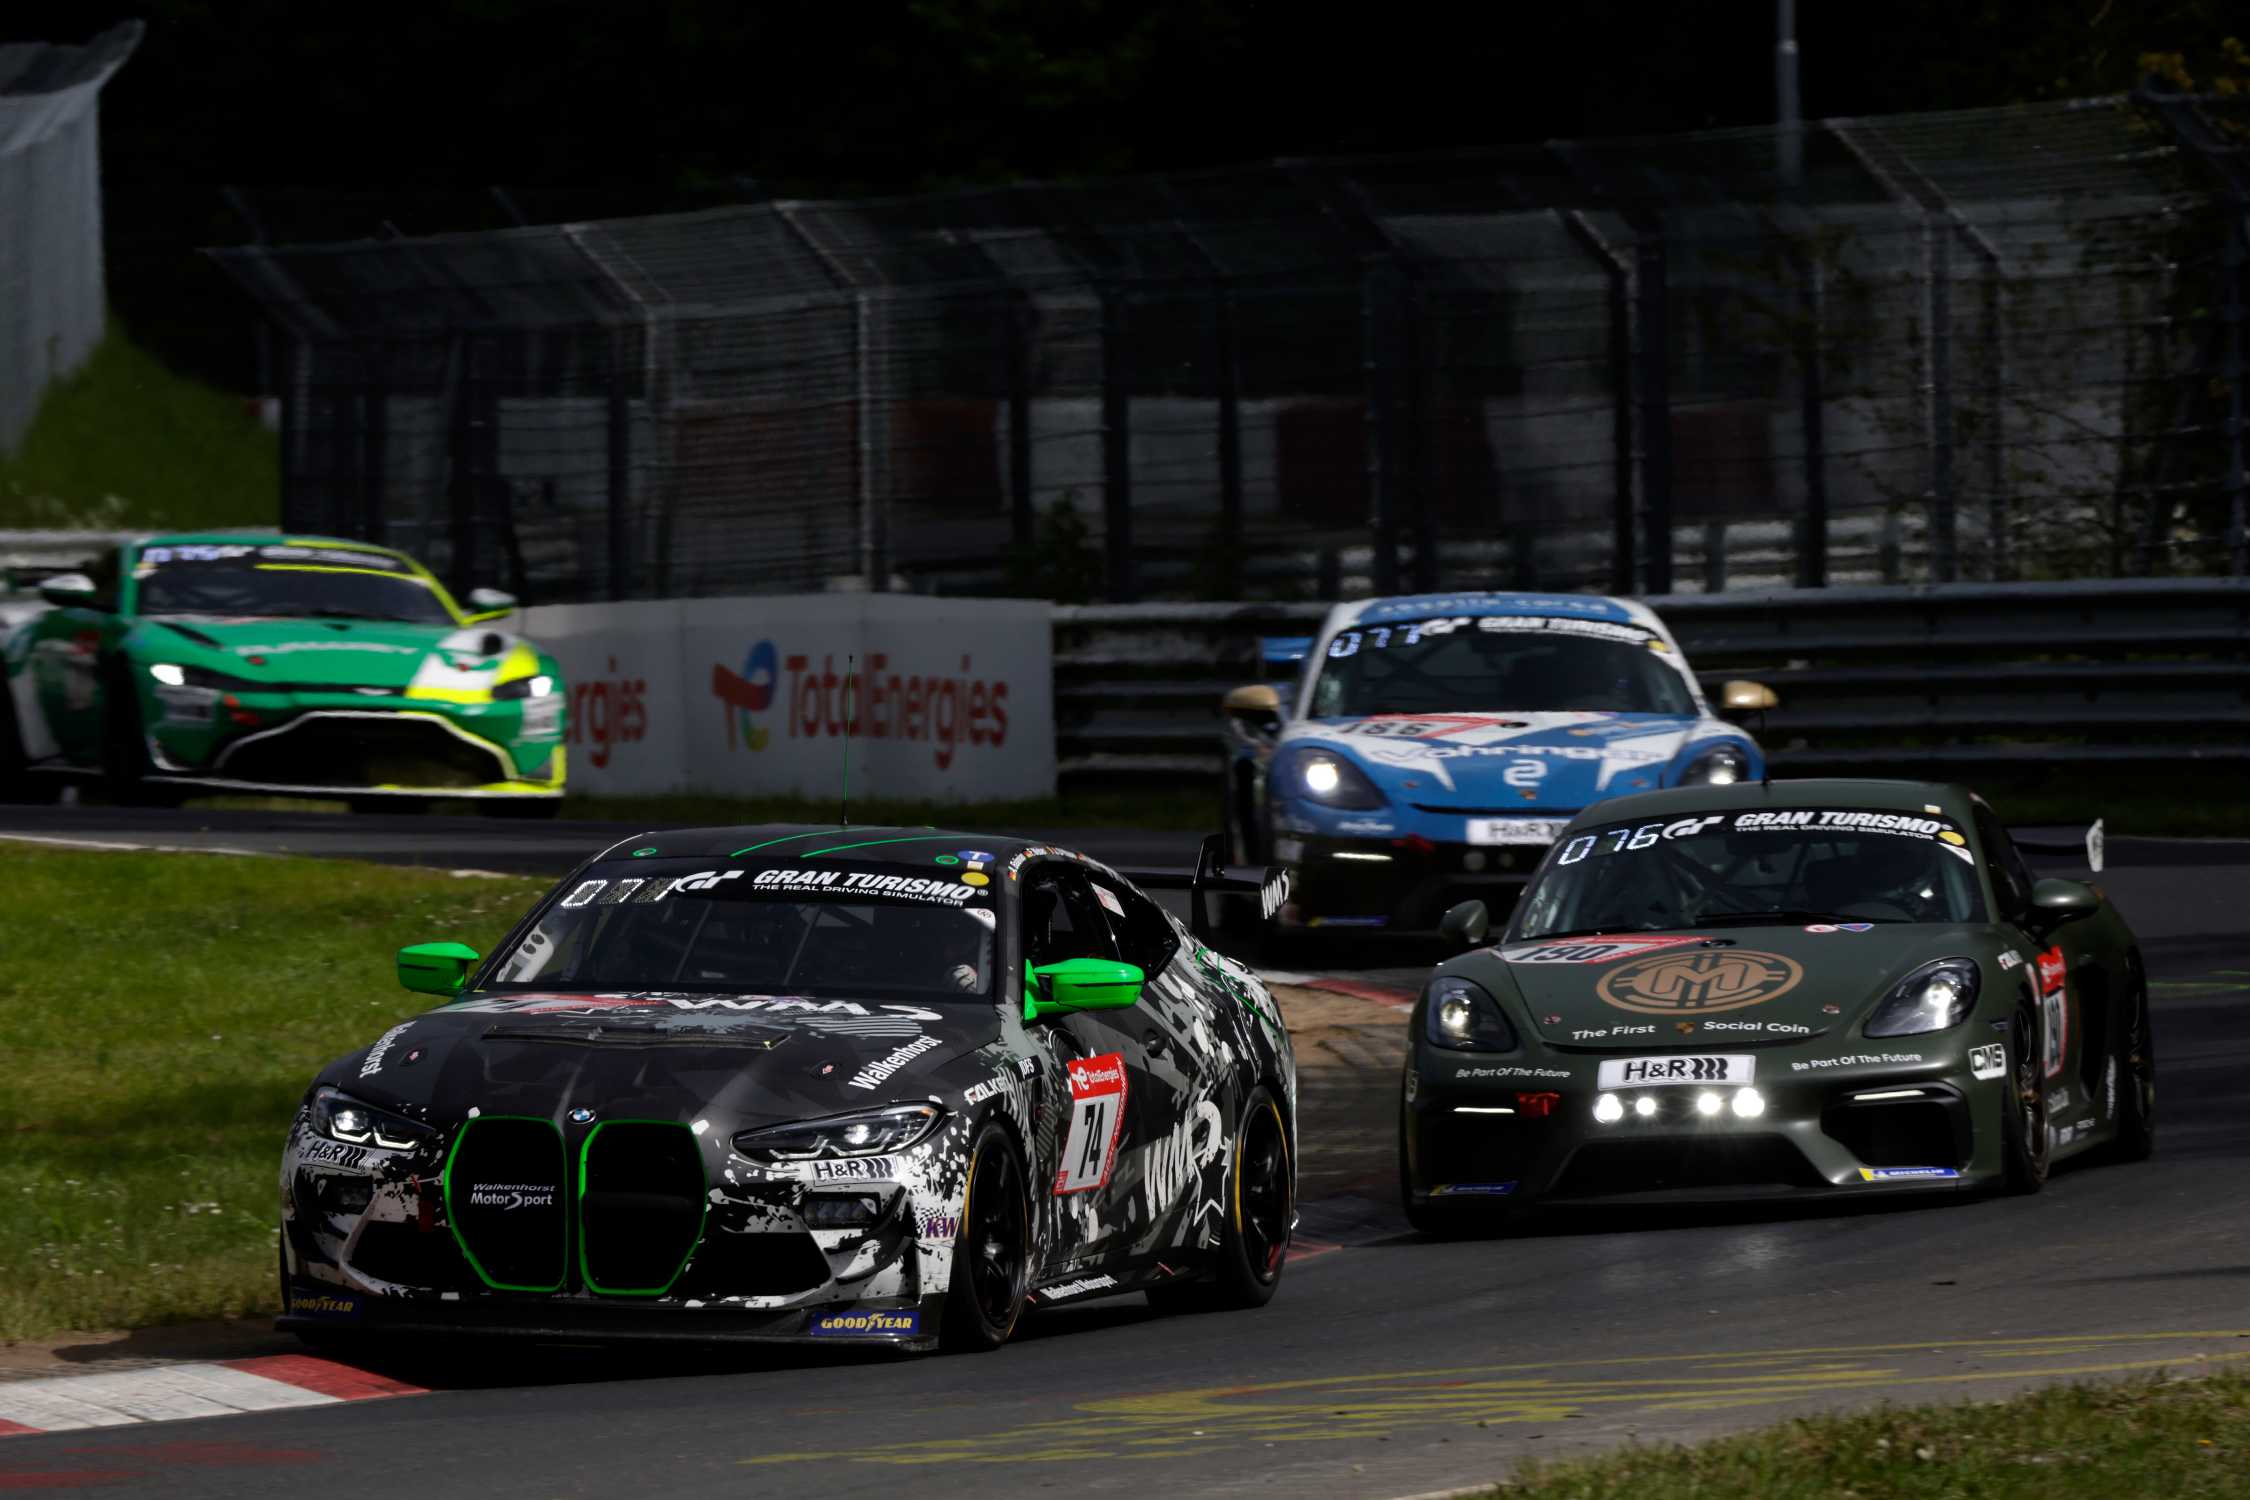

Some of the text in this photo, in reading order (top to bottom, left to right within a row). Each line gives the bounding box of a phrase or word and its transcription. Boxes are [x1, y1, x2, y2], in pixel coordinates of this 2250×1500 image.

[786, 654, 1009, 769] TotalEnergies
[1734, 811, 1942, 834] GRAN TURISMO
[1557, 823, 1665, 865] 076
[753, 869, 976, 900] GRAN TURISMO
[783, 884, 818, 892] REAL
[822, 885, 879, 895] DRIVING
[882, 890, 964, 907] SIMULATOR
[1261, 866, 1290, 920] WMS
[1512, 944, 1619, 962] 190
[1571, 1021, 1811, 1041] The First Social Coin
[848, 1034, 943, 1090] Walkenhorst
[1455, 1067, 1571, 1078] Be Part Of The Future
[1623, 1058, 1688, 1082] H&R
[1791, 1053, 1922, 1071] Be Part Of The Future
[306, 1140, 343, 1162] H&R
[1077, 1102, 1105, 1179] 74
[813, 1158, 863, 1179] H&R
[473, 1183, 556, 1192] Walkenhorst
[470, 1191, 553, 1211] MotorSport
[925, 1216, 960, 1239] KW
[820, 1313, 913, 1333] GOODYEAR
